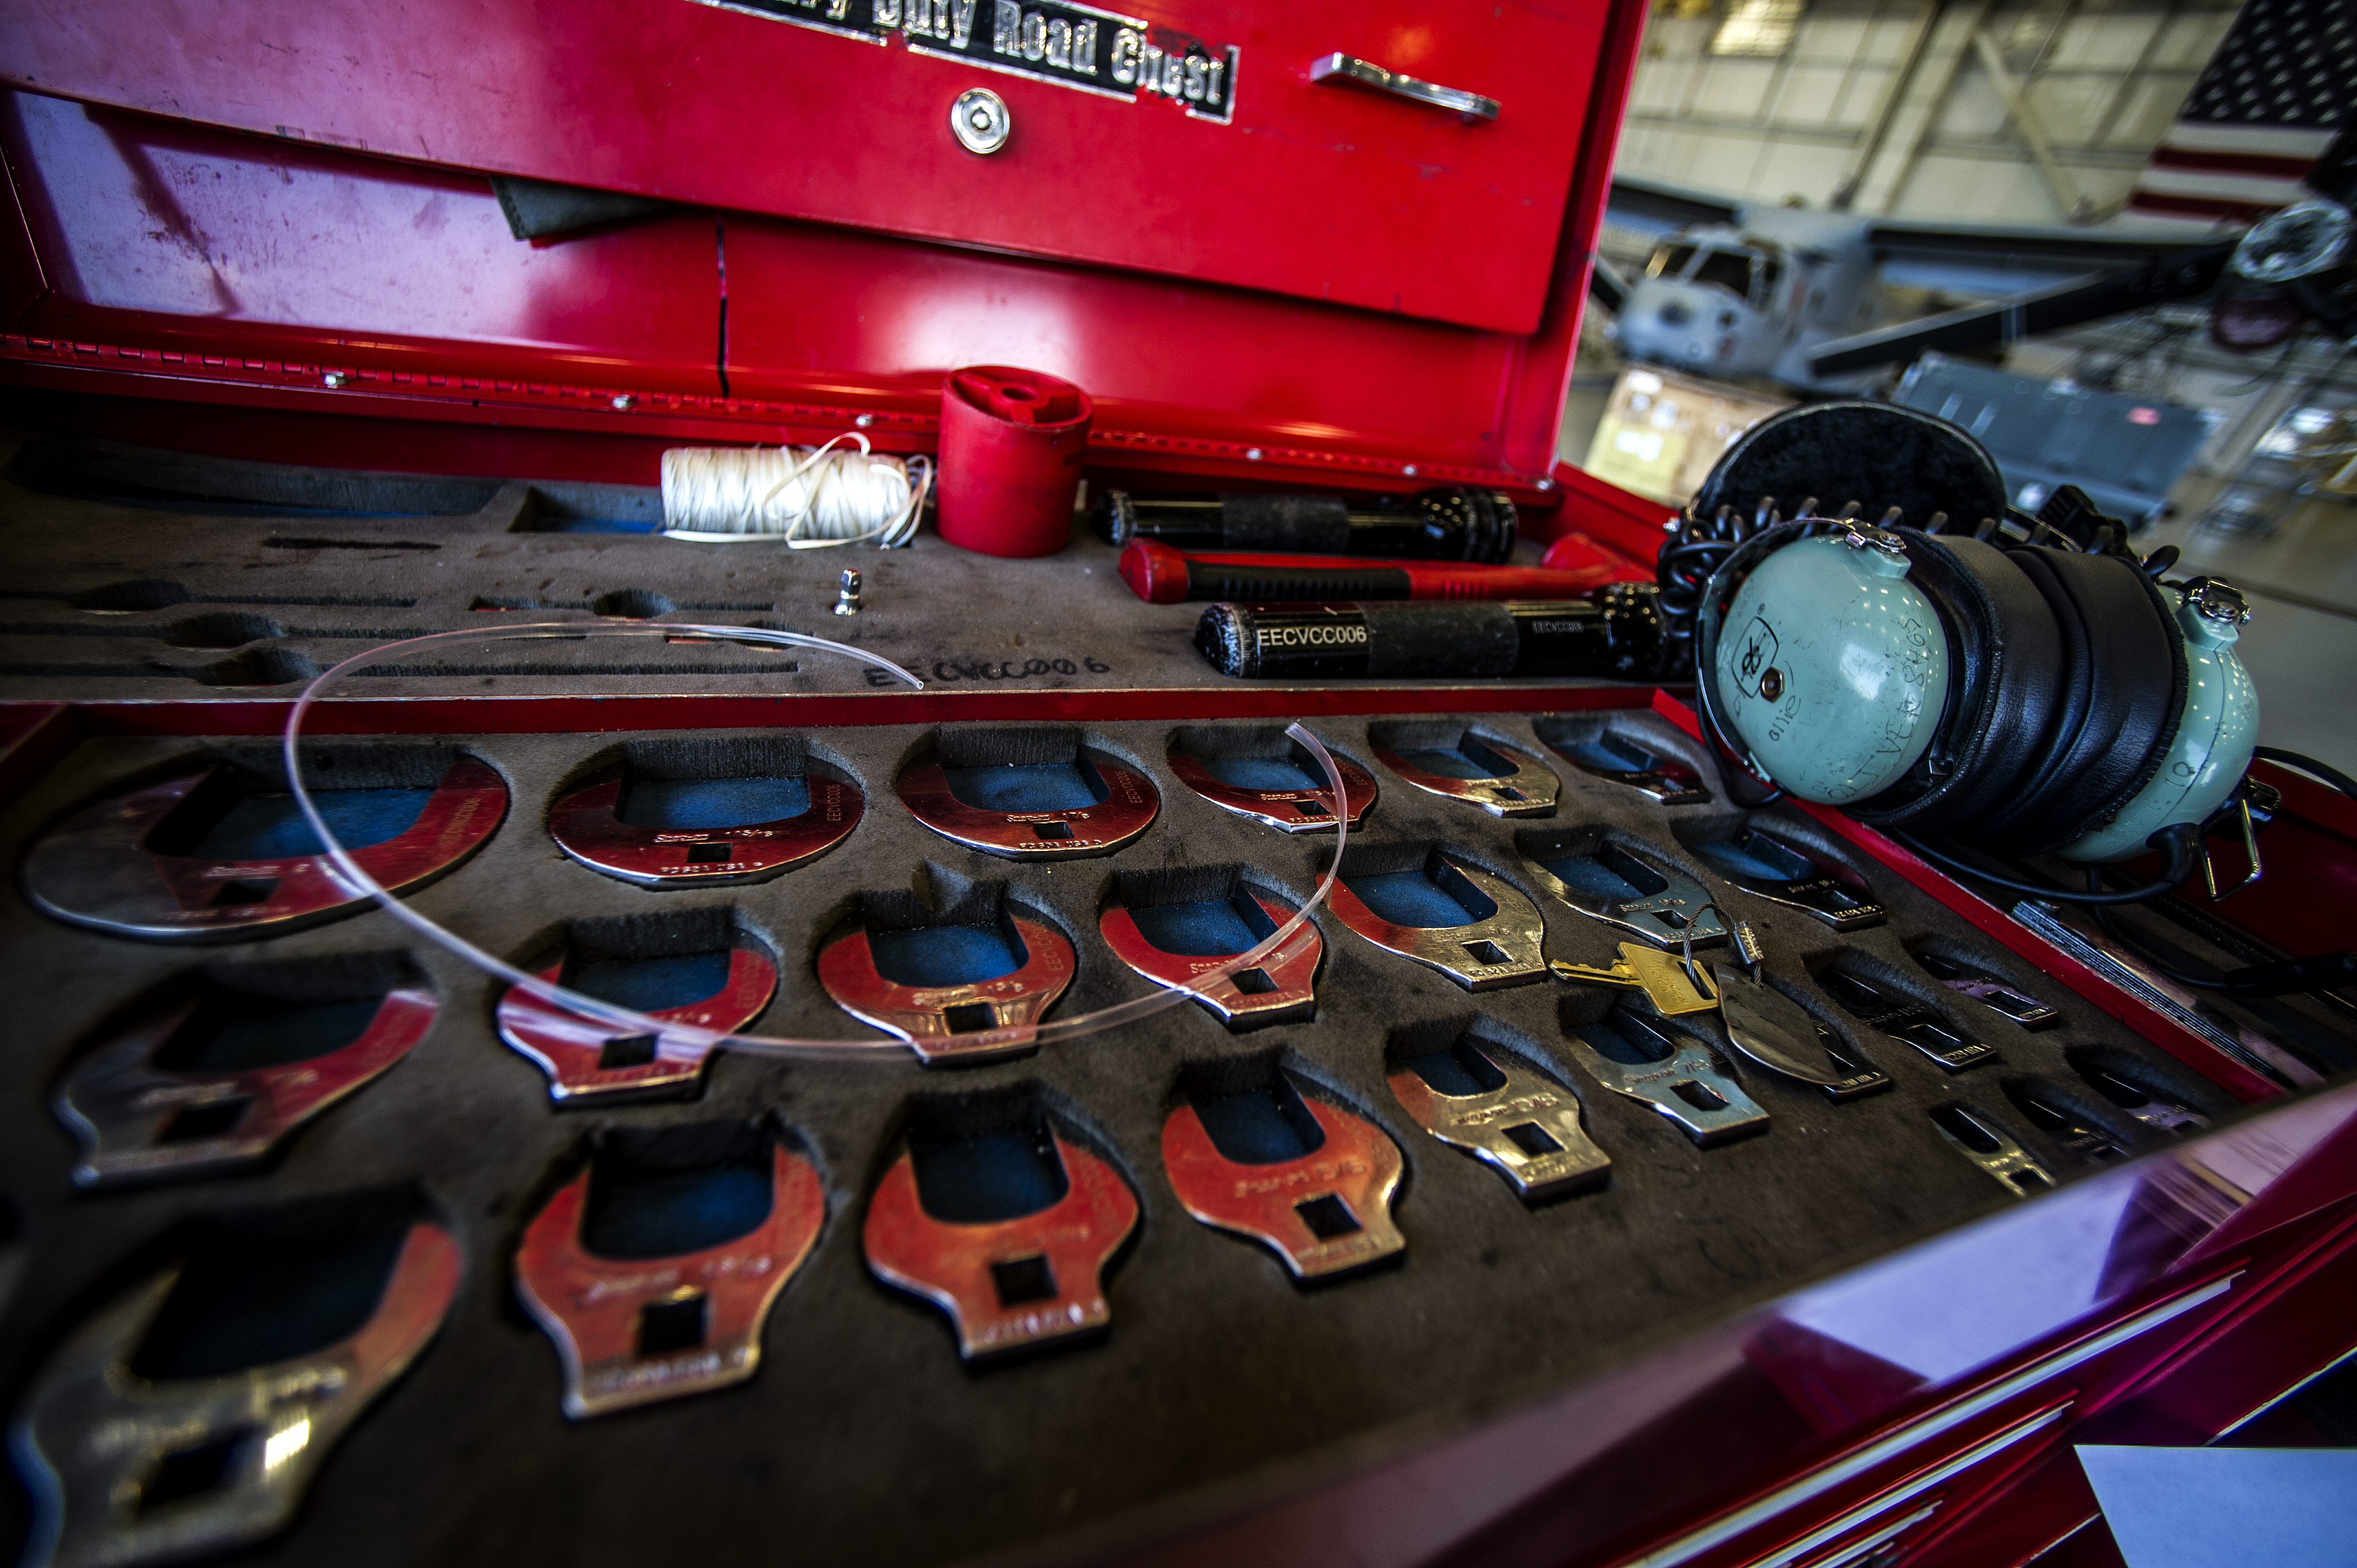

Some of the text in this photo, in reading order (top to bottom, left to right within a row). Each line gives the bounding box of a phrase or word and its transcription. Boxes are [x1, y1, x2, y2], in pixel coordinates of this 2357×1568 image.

[872, 0, 1223, 105] Duty Road Chest
[1258, 626, 1367, 647] EECVCC006
[826, 784, 841, 822] EECVCC006
[1115, 770, 1143, 804] EECVCC006
